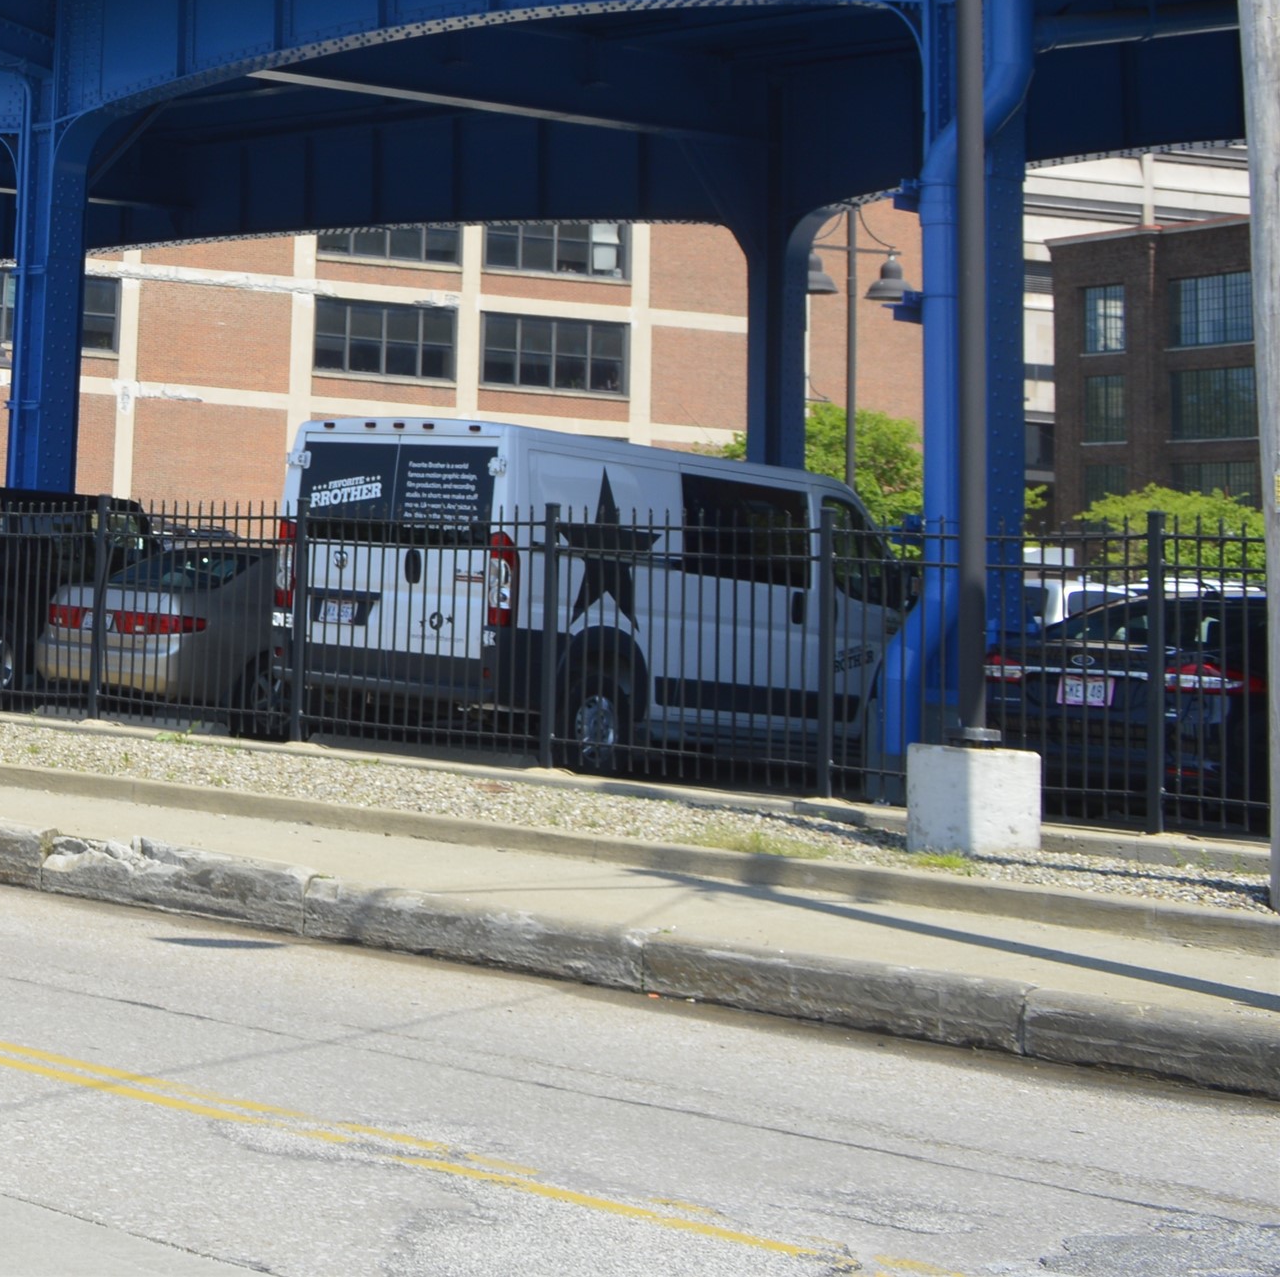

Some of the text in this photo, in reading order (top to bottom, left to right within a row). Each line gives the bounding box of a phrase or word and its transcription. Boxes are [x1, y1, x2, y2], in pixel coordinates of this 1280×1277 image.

[428, 461, 445, 469] Brother
[442, 472, 459, 480] graphic
[328, 476, 365, 489] FAVORITE
[452, 483, 476, 491] recording
[309, 482, 382, 508] BROTHER
